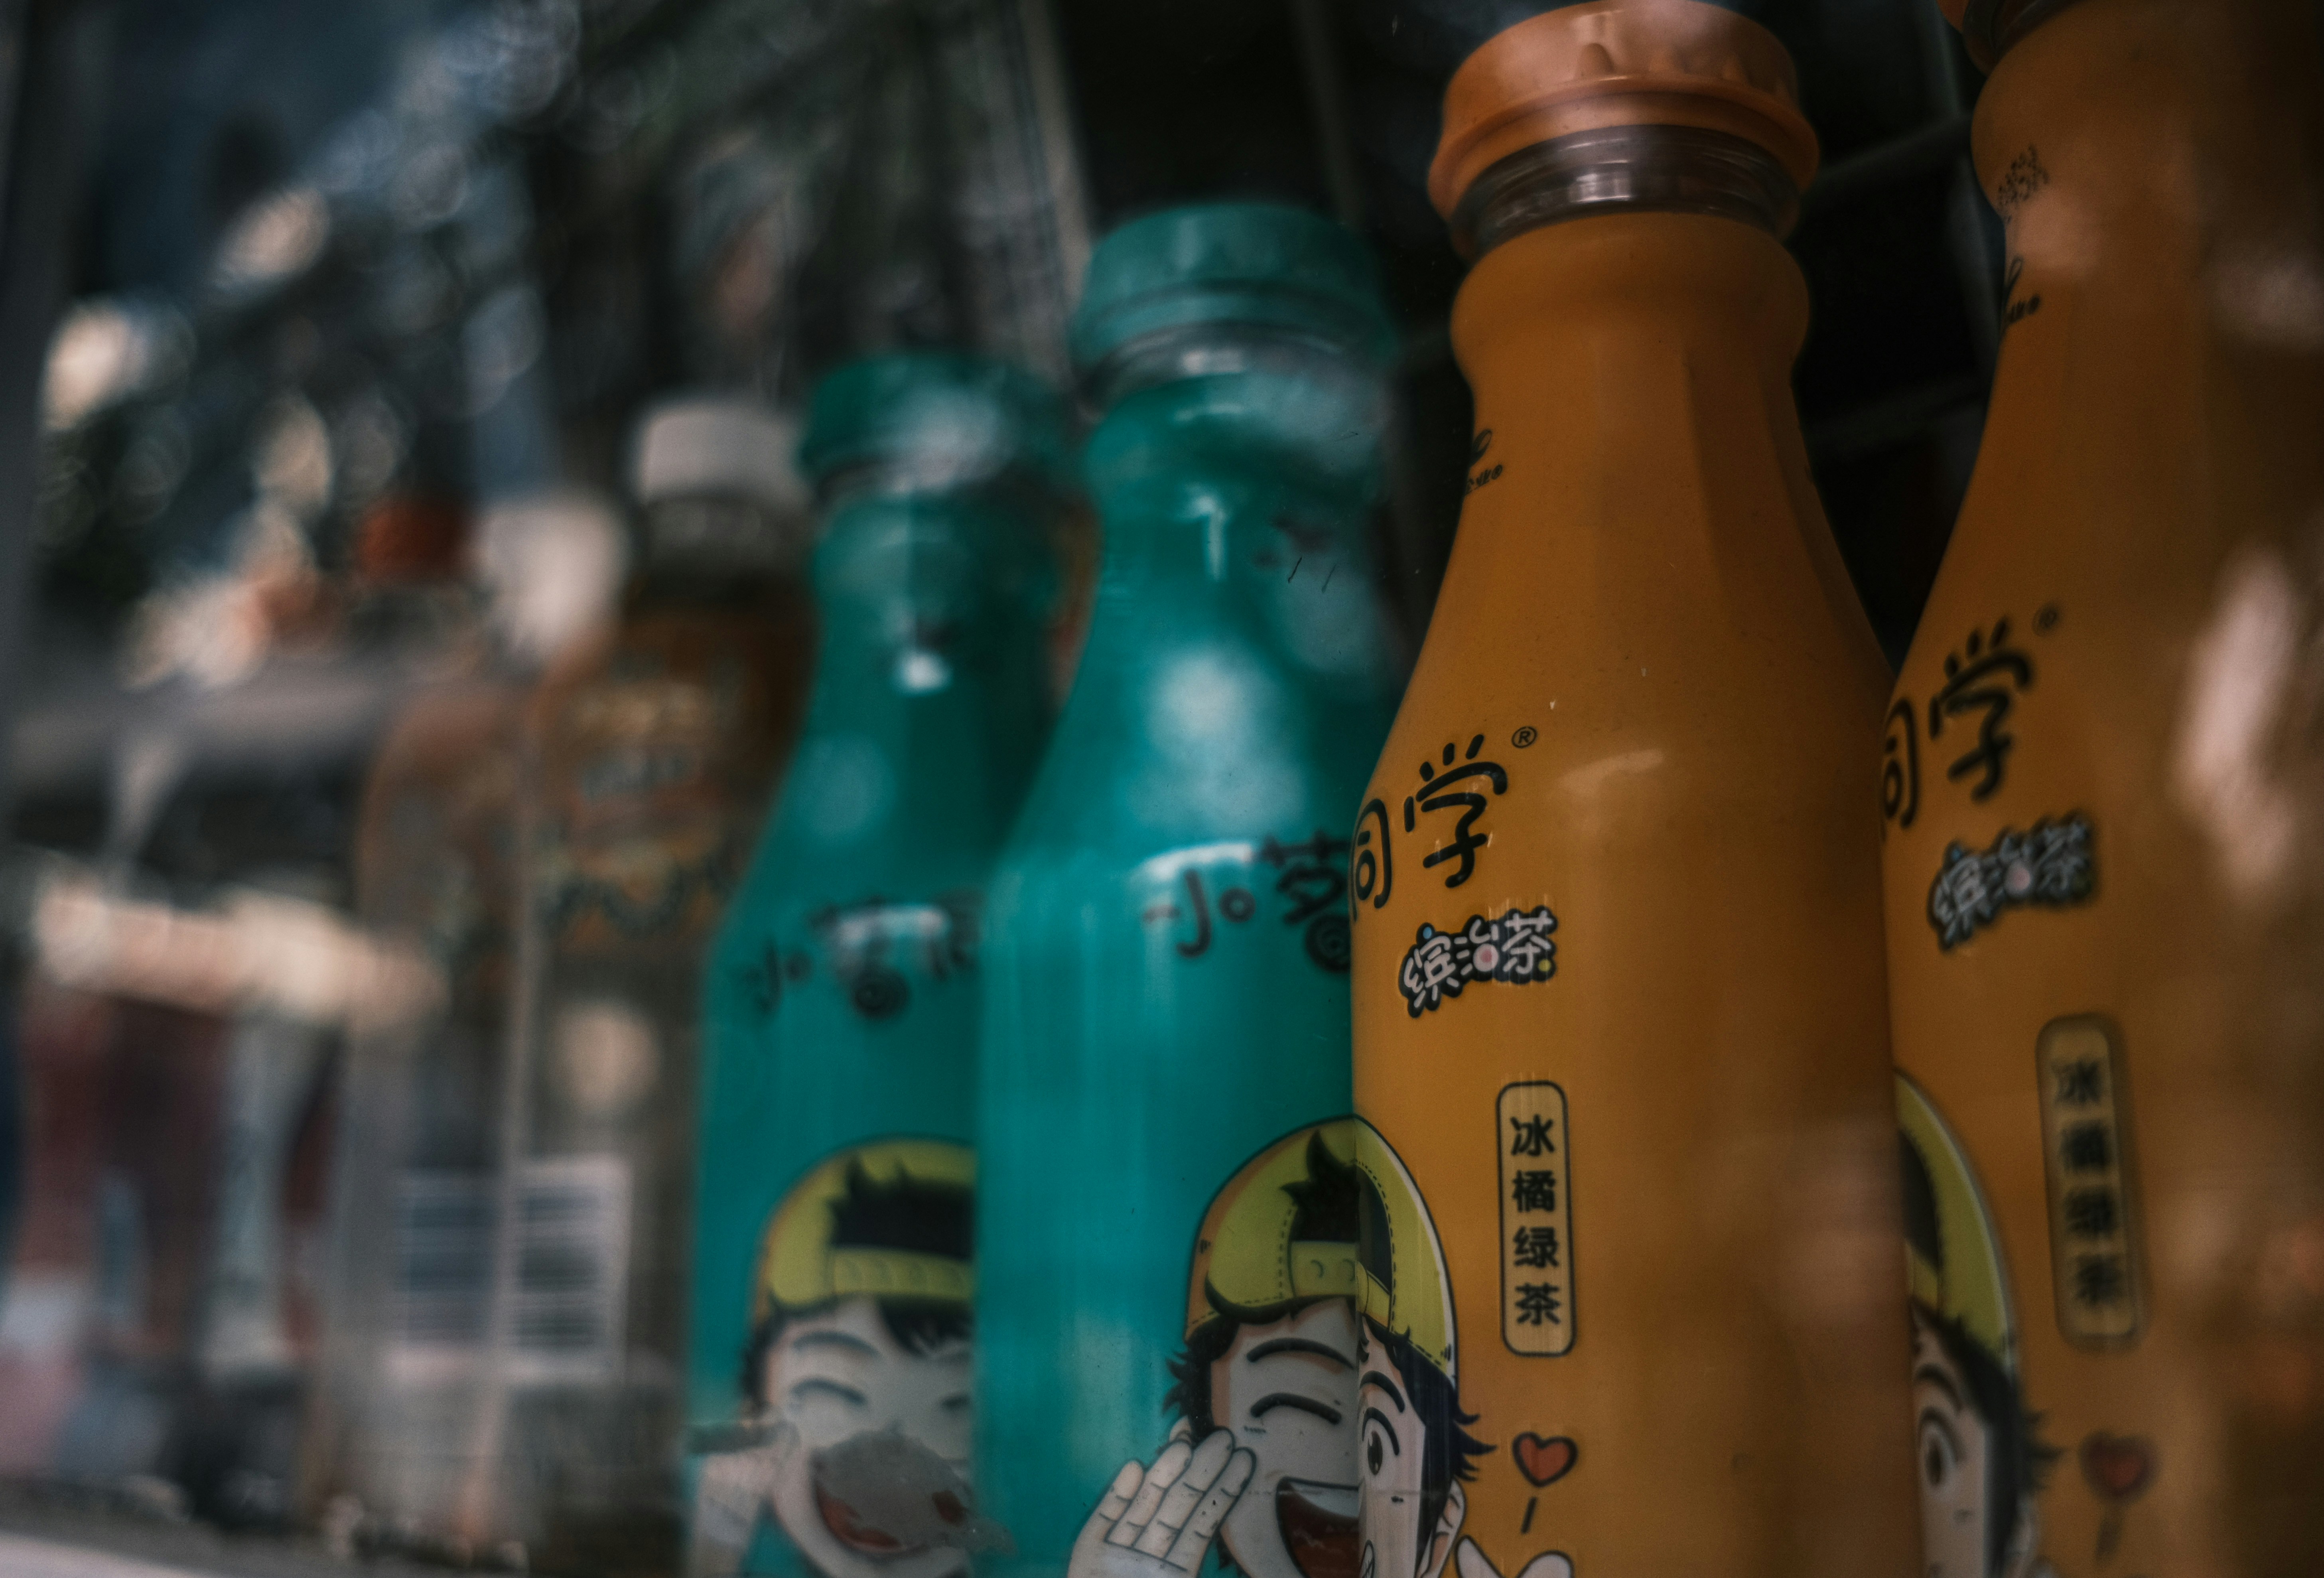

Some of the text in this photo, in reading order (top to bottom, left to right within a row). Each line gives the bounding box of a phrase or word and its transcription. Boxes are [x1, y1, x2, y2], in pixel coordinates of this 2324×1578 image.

[1400, 906, 1557, 1017] 缤治茶
[1510, 1114, 1560, 1326] 冰橘绿茶
